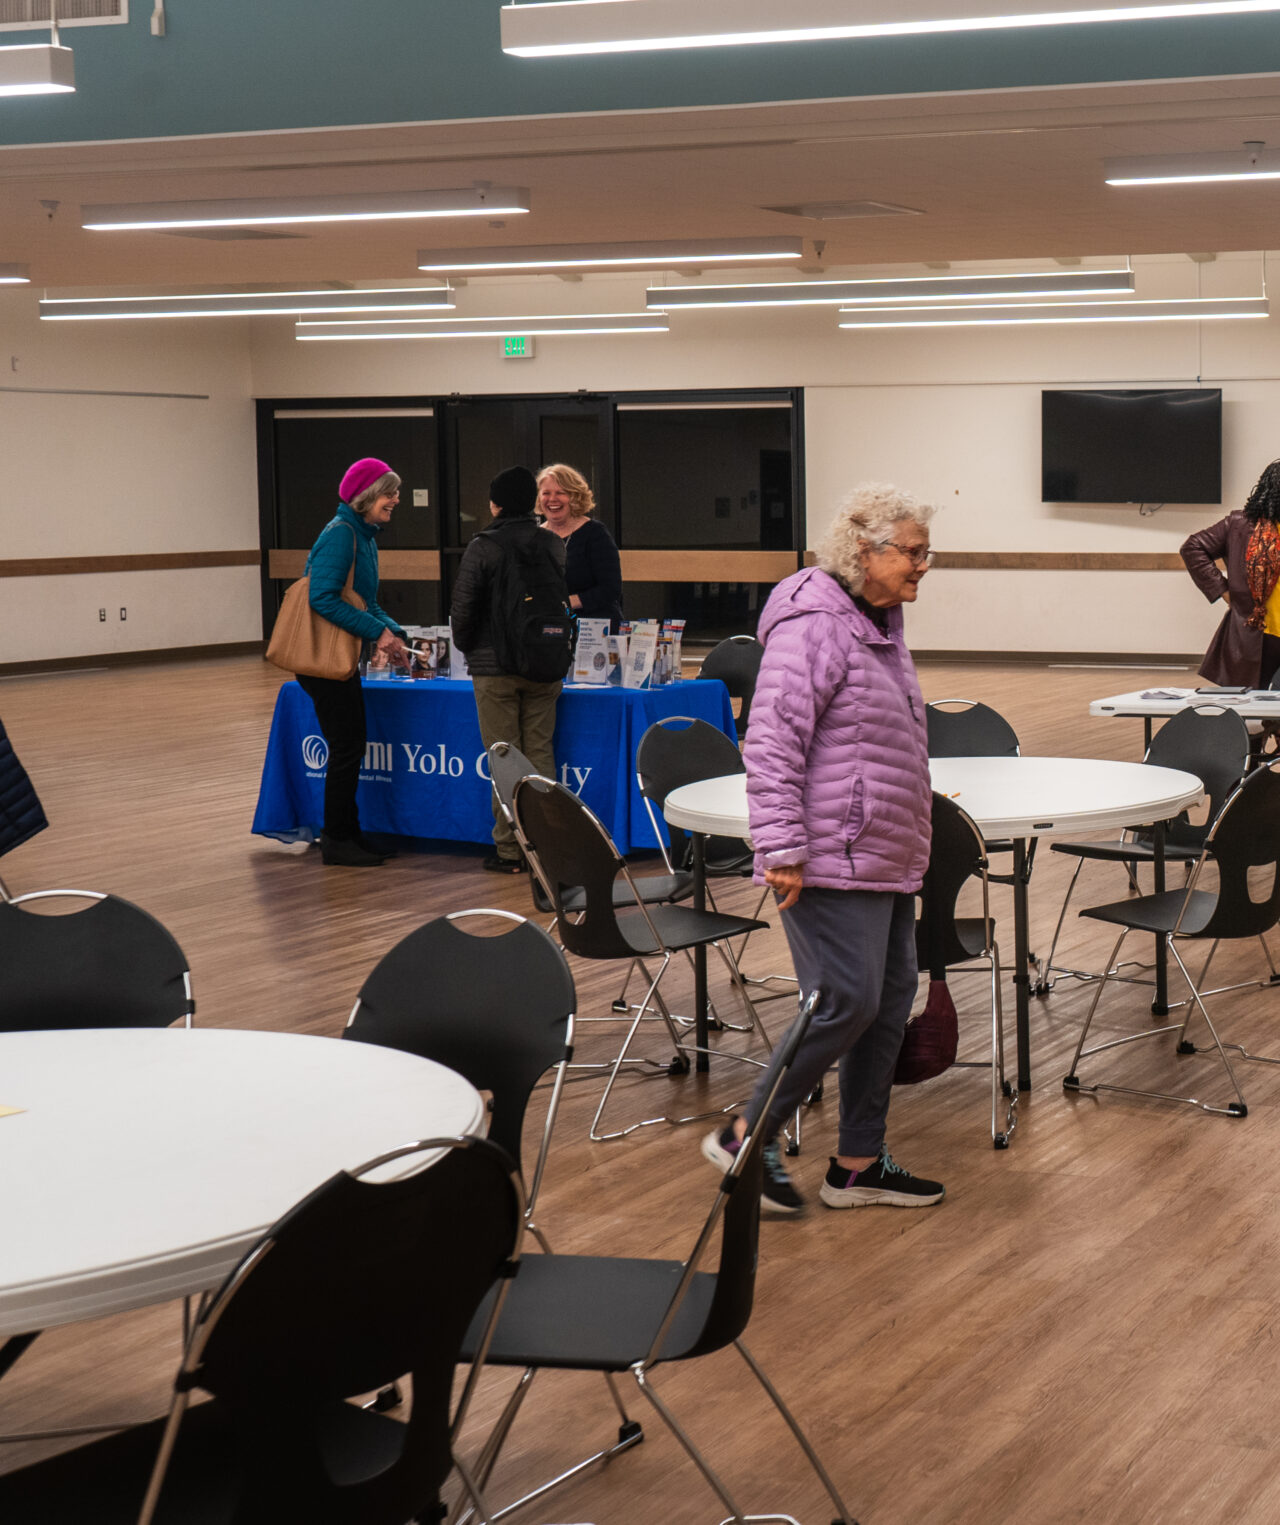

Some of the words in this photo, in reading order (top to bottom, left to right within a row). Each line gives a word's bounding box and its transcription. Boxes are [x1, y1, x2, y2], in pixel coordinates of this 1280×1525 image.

[505, 337, 525, 355] EXIT
[401, 743, 464, 777] Yolo
[475, 751, 592, 797] Cty
